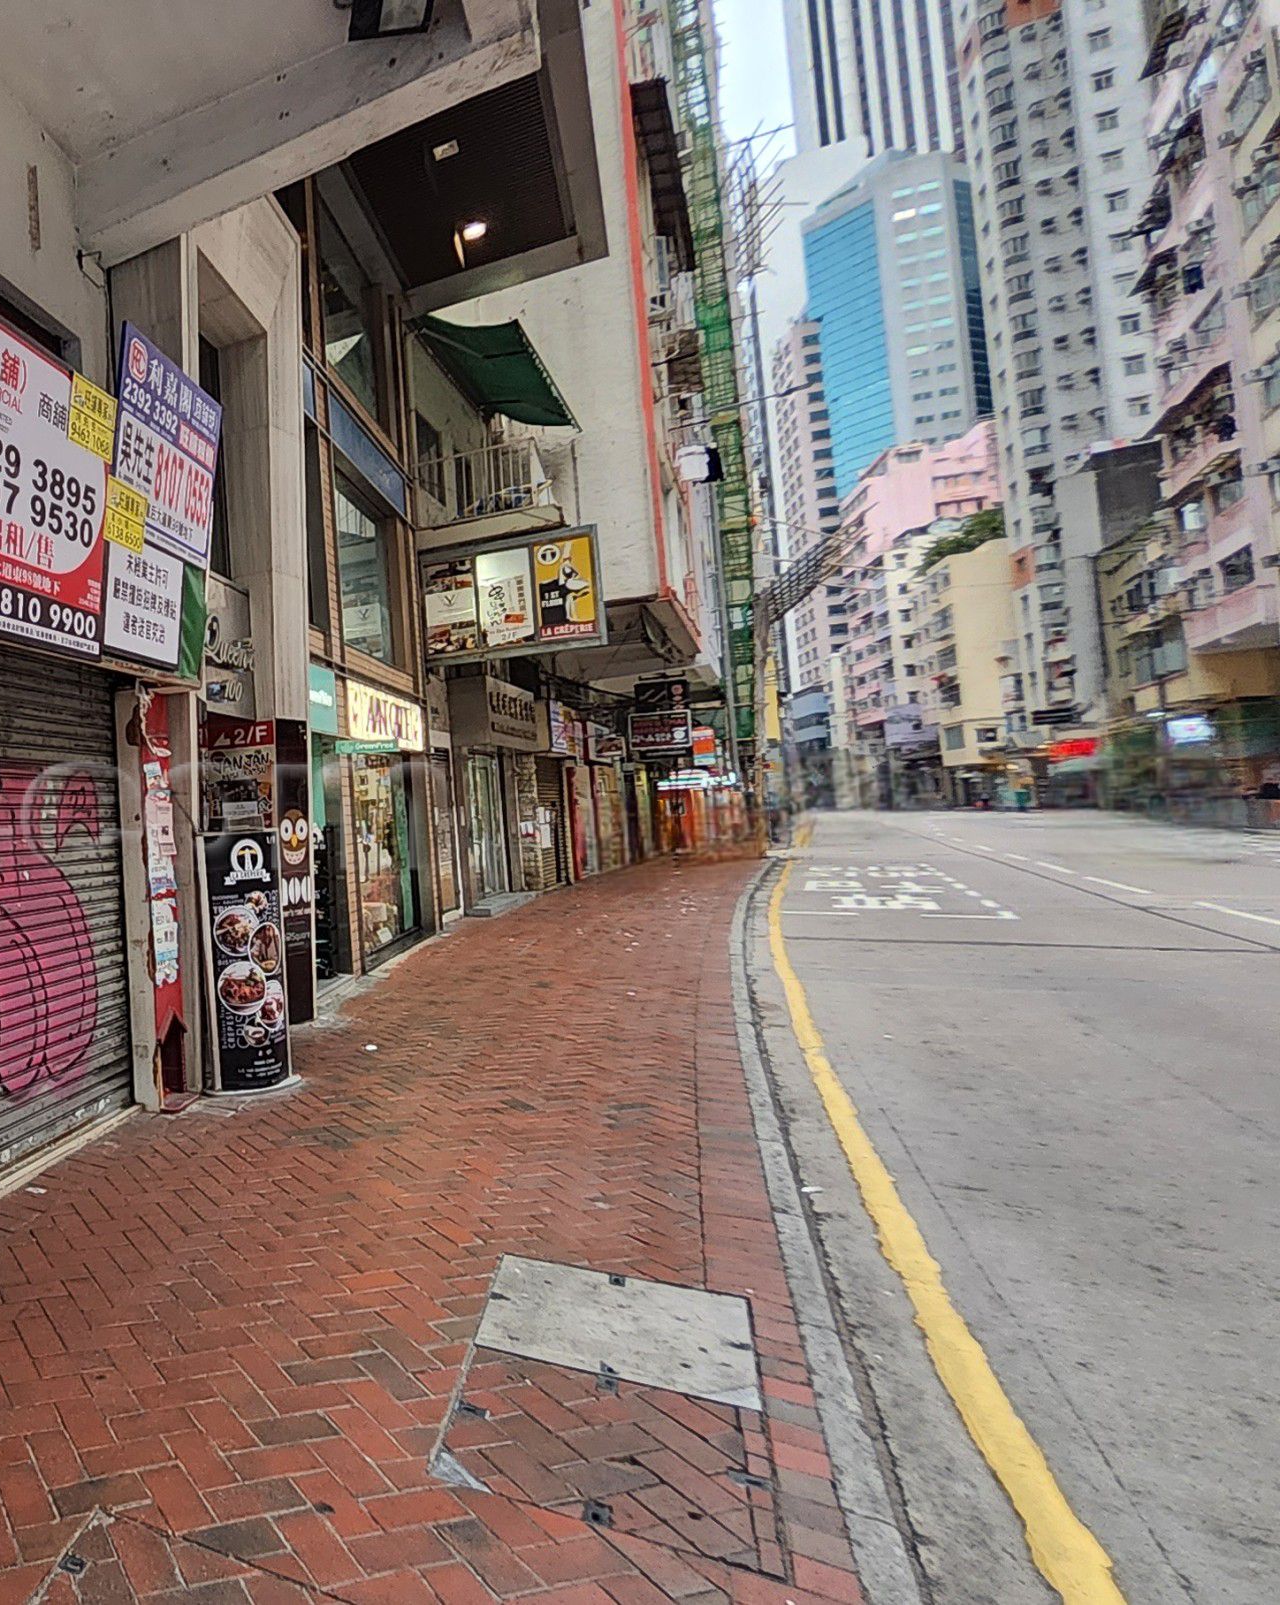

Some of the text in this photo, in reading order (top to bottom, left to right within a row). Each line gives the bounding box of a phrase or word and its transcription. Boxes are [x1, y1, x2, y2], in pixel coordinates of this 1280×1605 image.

[122, 377, 151, 415] 2392
[153, 400, 179, 436] 3392
[32, 458, 96, 516] 3895
[30, 494, 93, 549] 9530
[49, 603, 96, 640] 9900
[233, 724, 269, 744] 2/F
